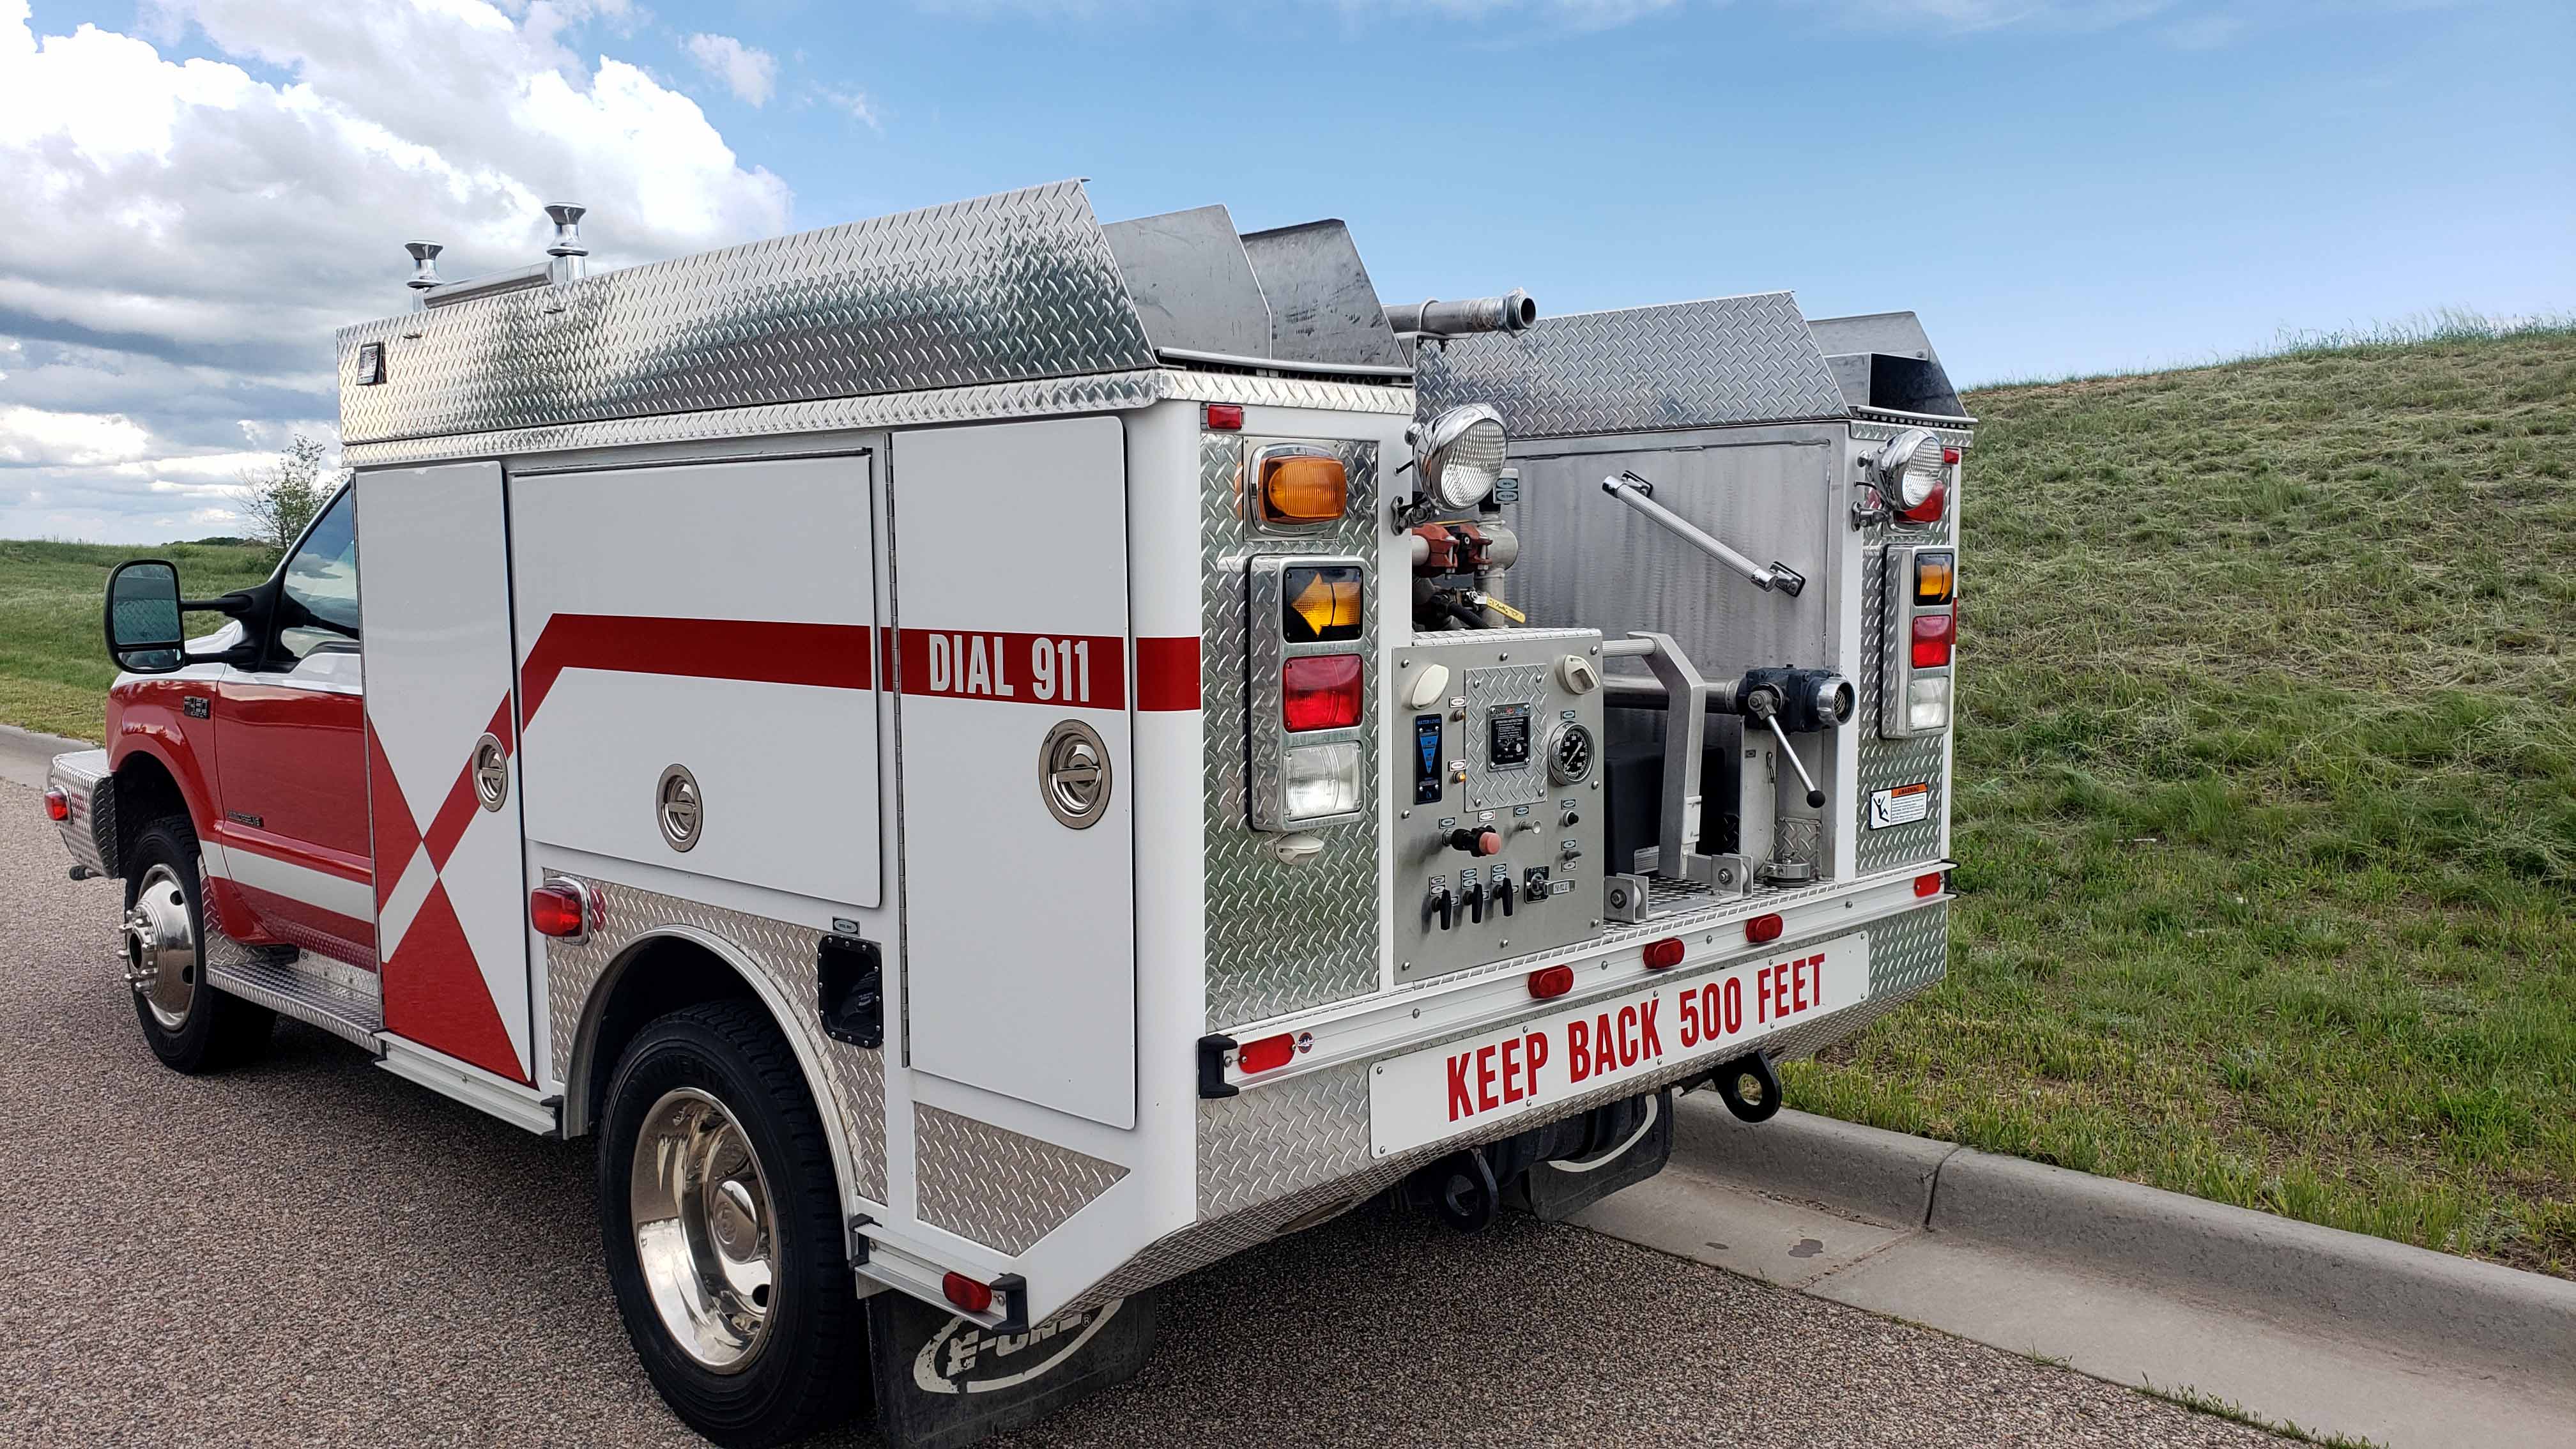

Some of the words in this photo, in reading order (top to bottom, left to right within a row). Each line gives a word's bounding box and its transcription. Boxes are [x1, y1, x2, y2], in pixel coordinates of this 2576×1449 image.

[929, 634, 1014, 696] DIAL
[1032, 638, 1089, 702] 911
[1446, 1031, 1549, 1123] KEEP
[1567, 998, 1663, 1084] BACK
[1679, 977, 1743, 1048] 500
[1757, 953, 1825, 1023] FEET
